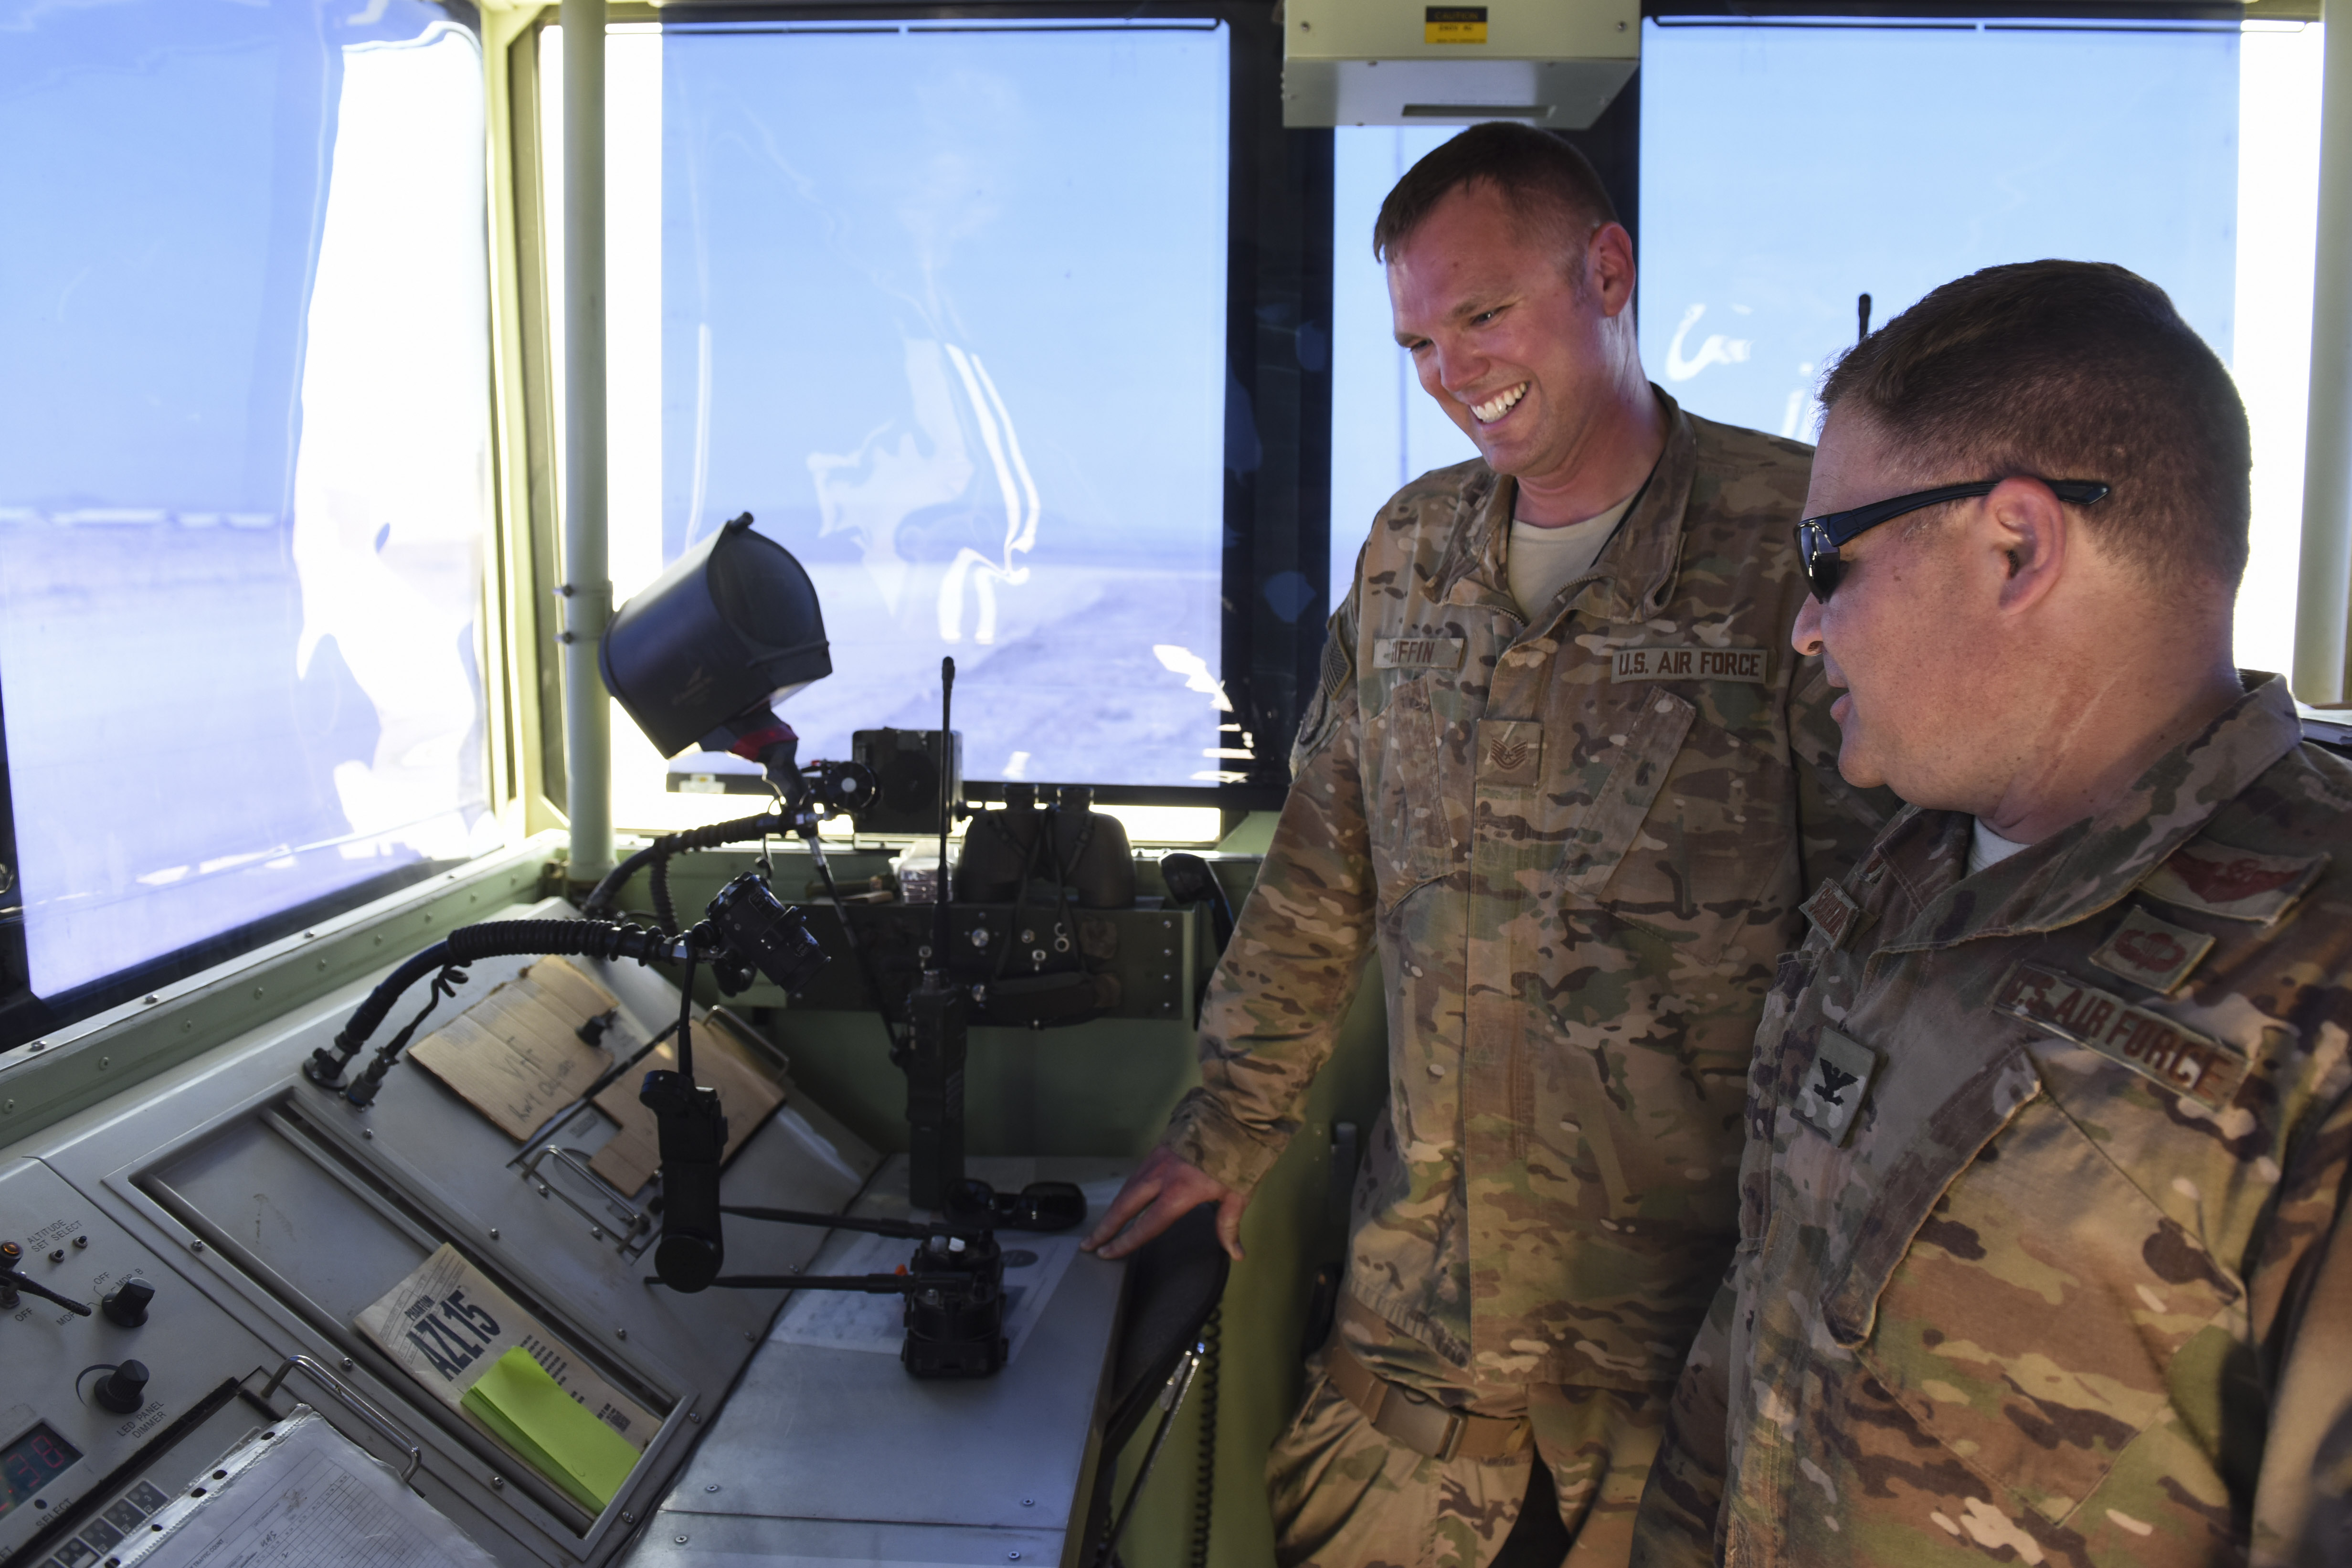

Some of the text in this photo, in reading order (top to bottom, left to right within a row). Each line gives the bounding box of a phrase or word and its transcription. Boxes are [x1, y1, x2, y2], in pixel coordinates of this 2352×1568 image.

[1619, 651, 1761, 676] U.S. AIR FORCE
[2055, 989, 2116, 1038] AIR
[2105, 1009, 2232, 1100] FORCE
[27, 1219, 66, 1244] ALTITUDE
[32, 1220, 83, 1252] SET SELECT
[94, 1271, 110, 1285] OFF
[15, 1307, 32, 1322] OFF
[117, 1401, 164, 1437] LED PANEL
[132, 1411, 167, 1439] DIMMER
[35, 1497, 72, 1528] SELECT
[0, 1546, 13, 1562] ET
[193, 1550, 211, 1567] TRAFFIC
[209, 1538, 224, 1553] COUNT
